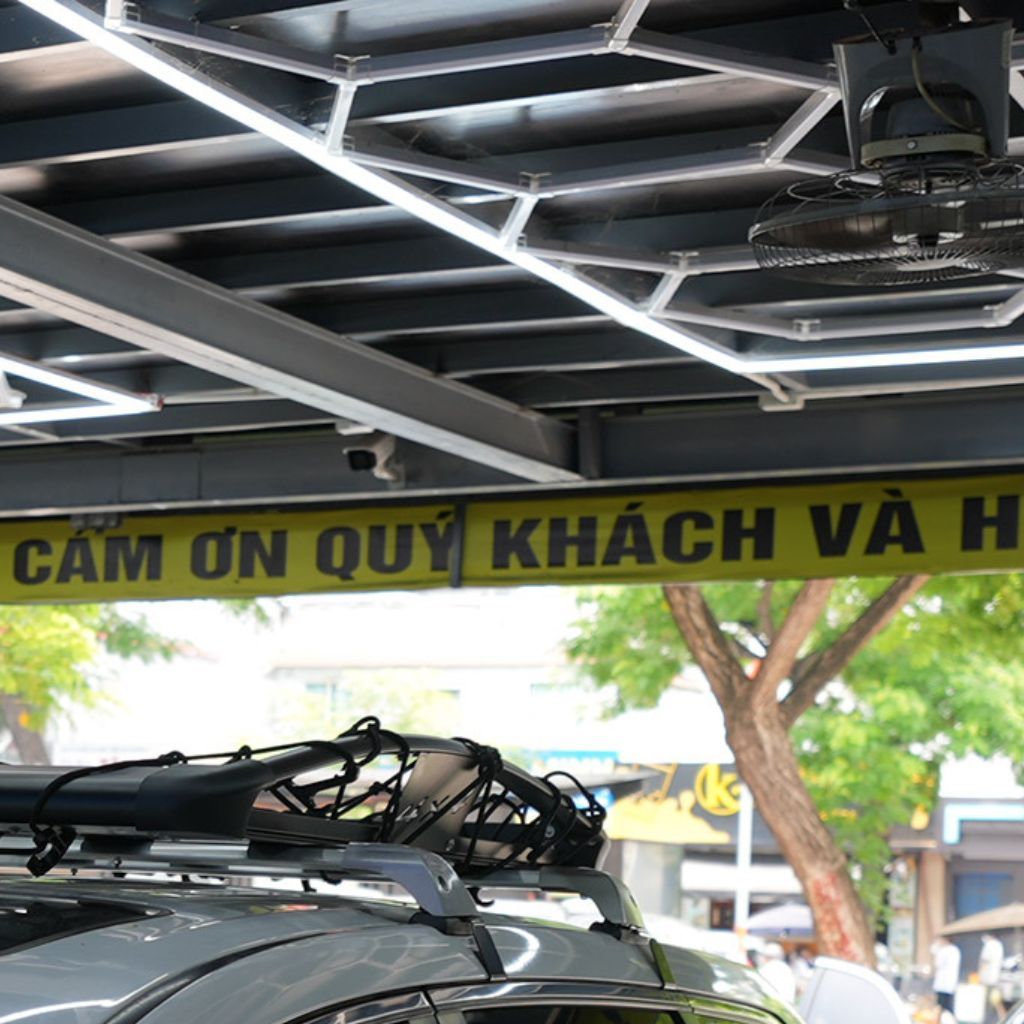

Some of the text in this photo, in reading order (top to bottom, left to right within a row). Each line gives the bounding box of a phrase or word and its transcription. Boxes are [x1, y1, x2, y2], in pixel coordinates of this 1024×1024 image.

[189, 526, 288, 580] ƠN
[316, 510, 454, 581] QUÝ
[491, 502, 775, 570] KHÁCH
[809, 489, 925, 558] VÀ
